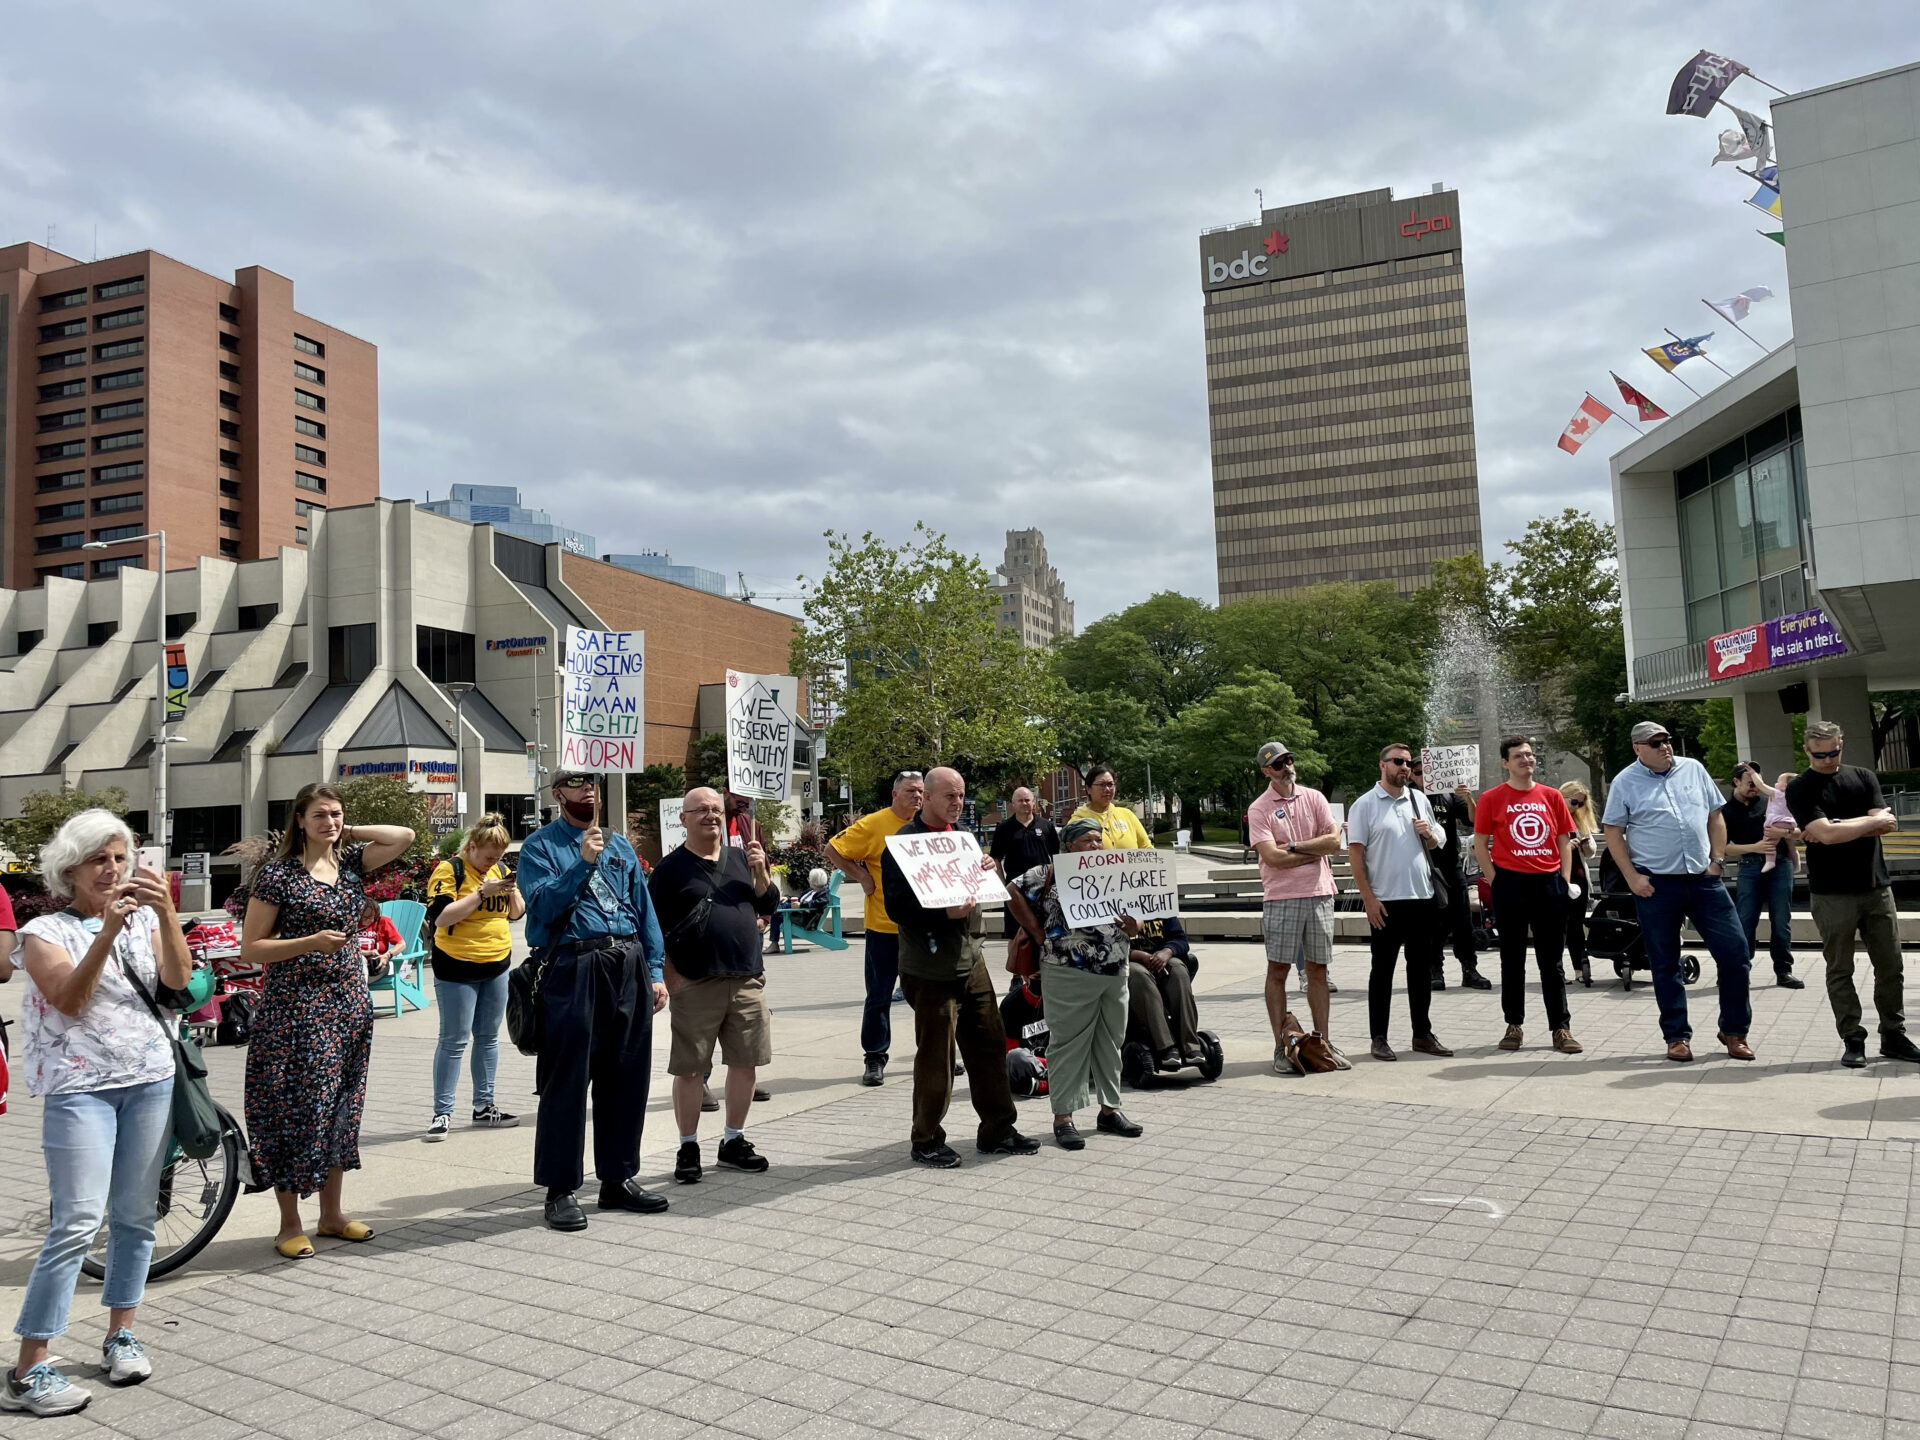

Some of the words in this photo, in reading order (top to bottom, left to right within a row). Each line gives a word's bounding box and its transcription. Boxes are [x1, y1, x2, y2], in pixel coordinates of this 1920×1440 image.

[1207, 250, 1269, 283] bdc
[1780, 615, 1817, 634] Everyone
[577, 630, 632, 652] SAFE
[1804, 636, 1814, 651] in
[1814, 631, 1834, 648] their
[567, 651, 642, 676] HOUSING
[575, 676, 592, 692] IS
[607, 676, 619, 693] A
[567, 692, 636, 714] HUMAN
[740, 698, 775, 720] WE
[566, 710, 639, 734] RIGHT!
[732, 718, 788, 742] DESERVE
[563, 738, 634, 769] ACORN
[733, 740, 788, 768] HEALTHY
[1430, 750, 1443, 760] WE
[1432, 759, 1465, 770] DESERVE
[733, 765, 784, 792] HOMES
[1422, 749, 1435, 793] ACORN
[1434, 768, 1464, 780] COOKED
[1437, 781, 1454, 790] OUR
[1506, 803, 1547, 814] ACORN
[899, 840, 924, 857] WE
[925, 836, 957, 856] NEED
[961, 836, 974, 851] A
[1078, 853, 1125, 870] ACORN
[1128, 857, 1164, 865] RESULTS
[911, 861, 935, 895] MAX
[933, 858, 961, 888] HEAT
[1068, 875, 1115, 901] 98%
[1119, 869, 1168, 892] AGREE
[1069, 899, 1127, 921] COOLING
[1139, 892, 1175, 915] RIGHT
